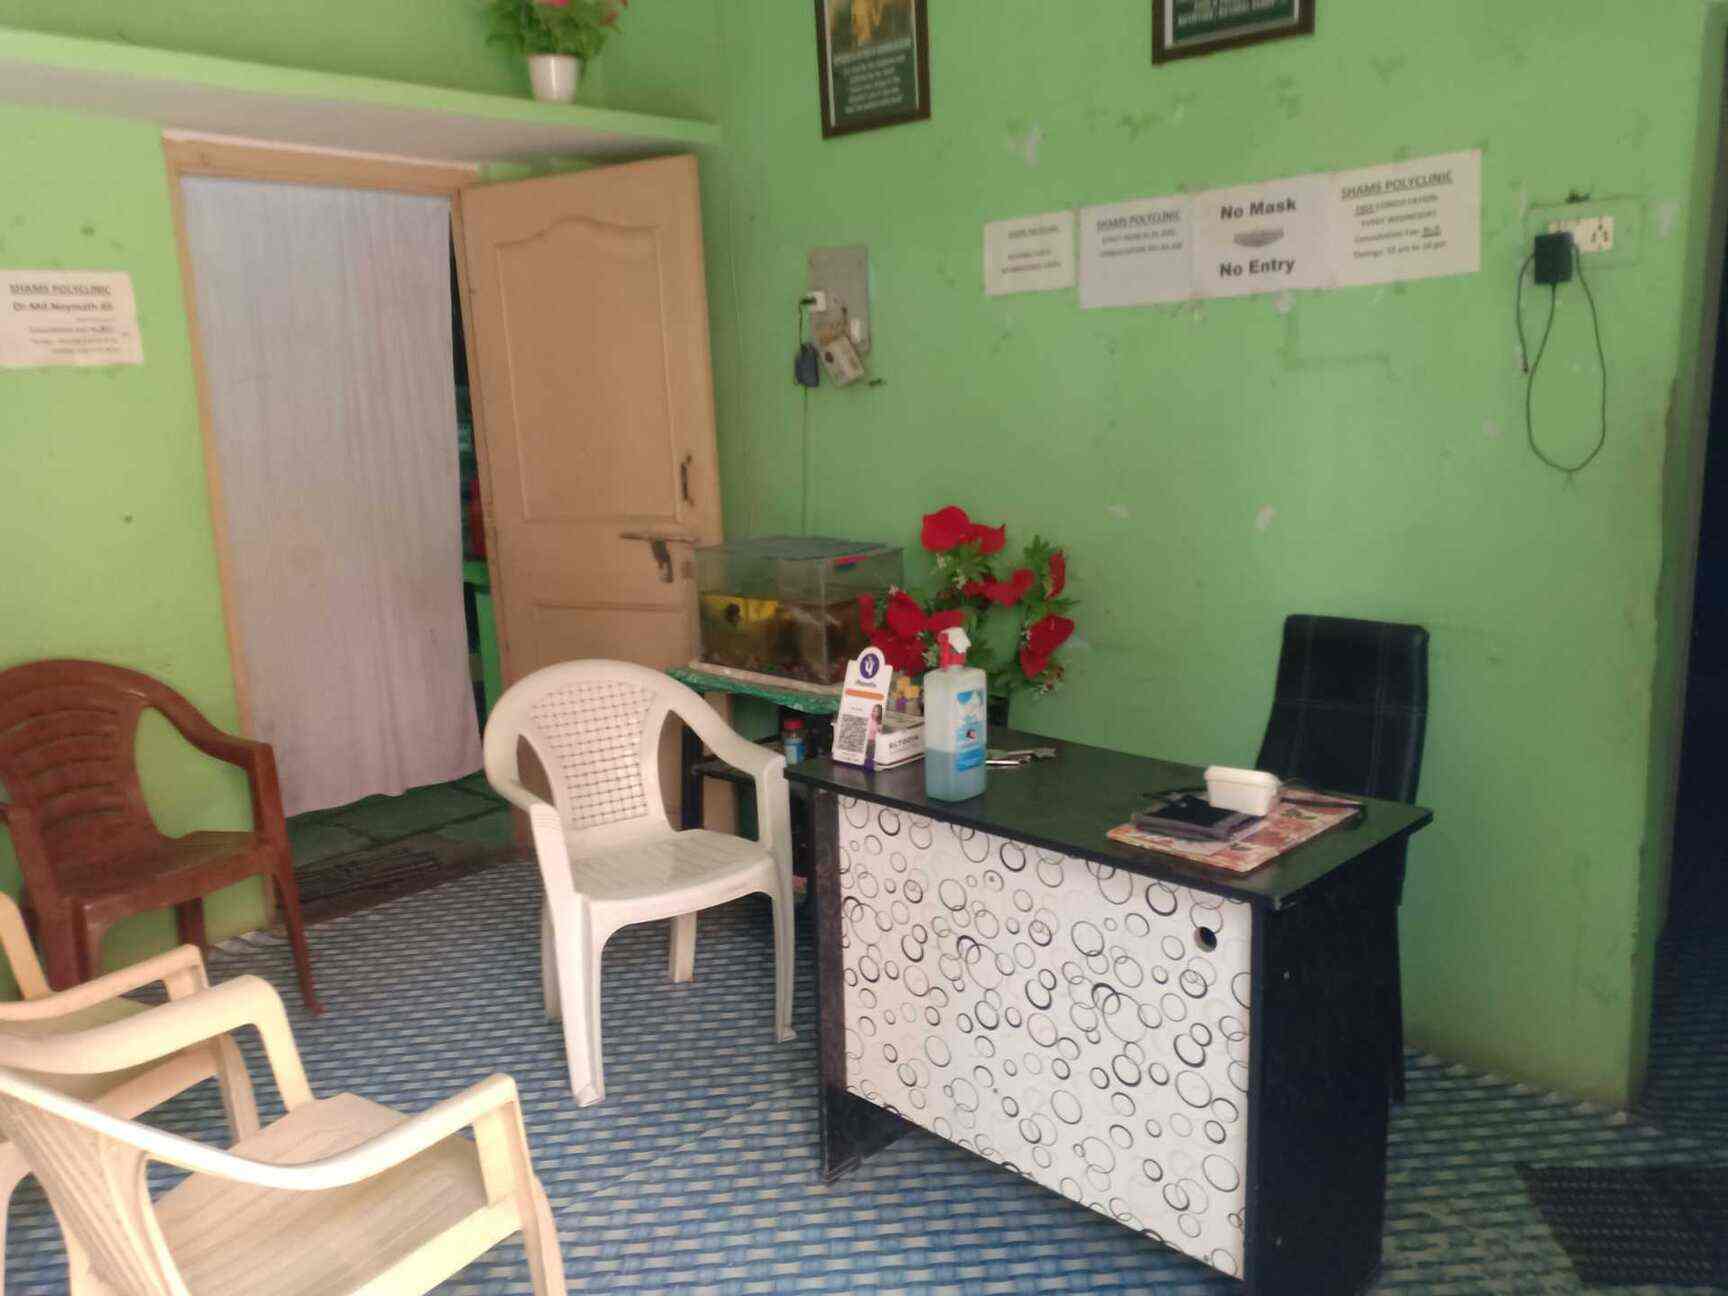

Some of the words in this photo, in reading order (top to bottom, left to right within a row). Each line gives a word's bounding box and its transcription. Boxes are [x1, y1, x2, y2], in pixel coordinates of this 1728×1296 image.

[1341, 182, 1382, 201] SHAMS
[1384, 170, 1454, 191] POLYCLINIC
[1219, 205, 1244, 221] No
[1249, 196, 1297, 216] Mask
[1219, 261, 1243, 278] No
[1249, 257, 1296, 275] Entry
